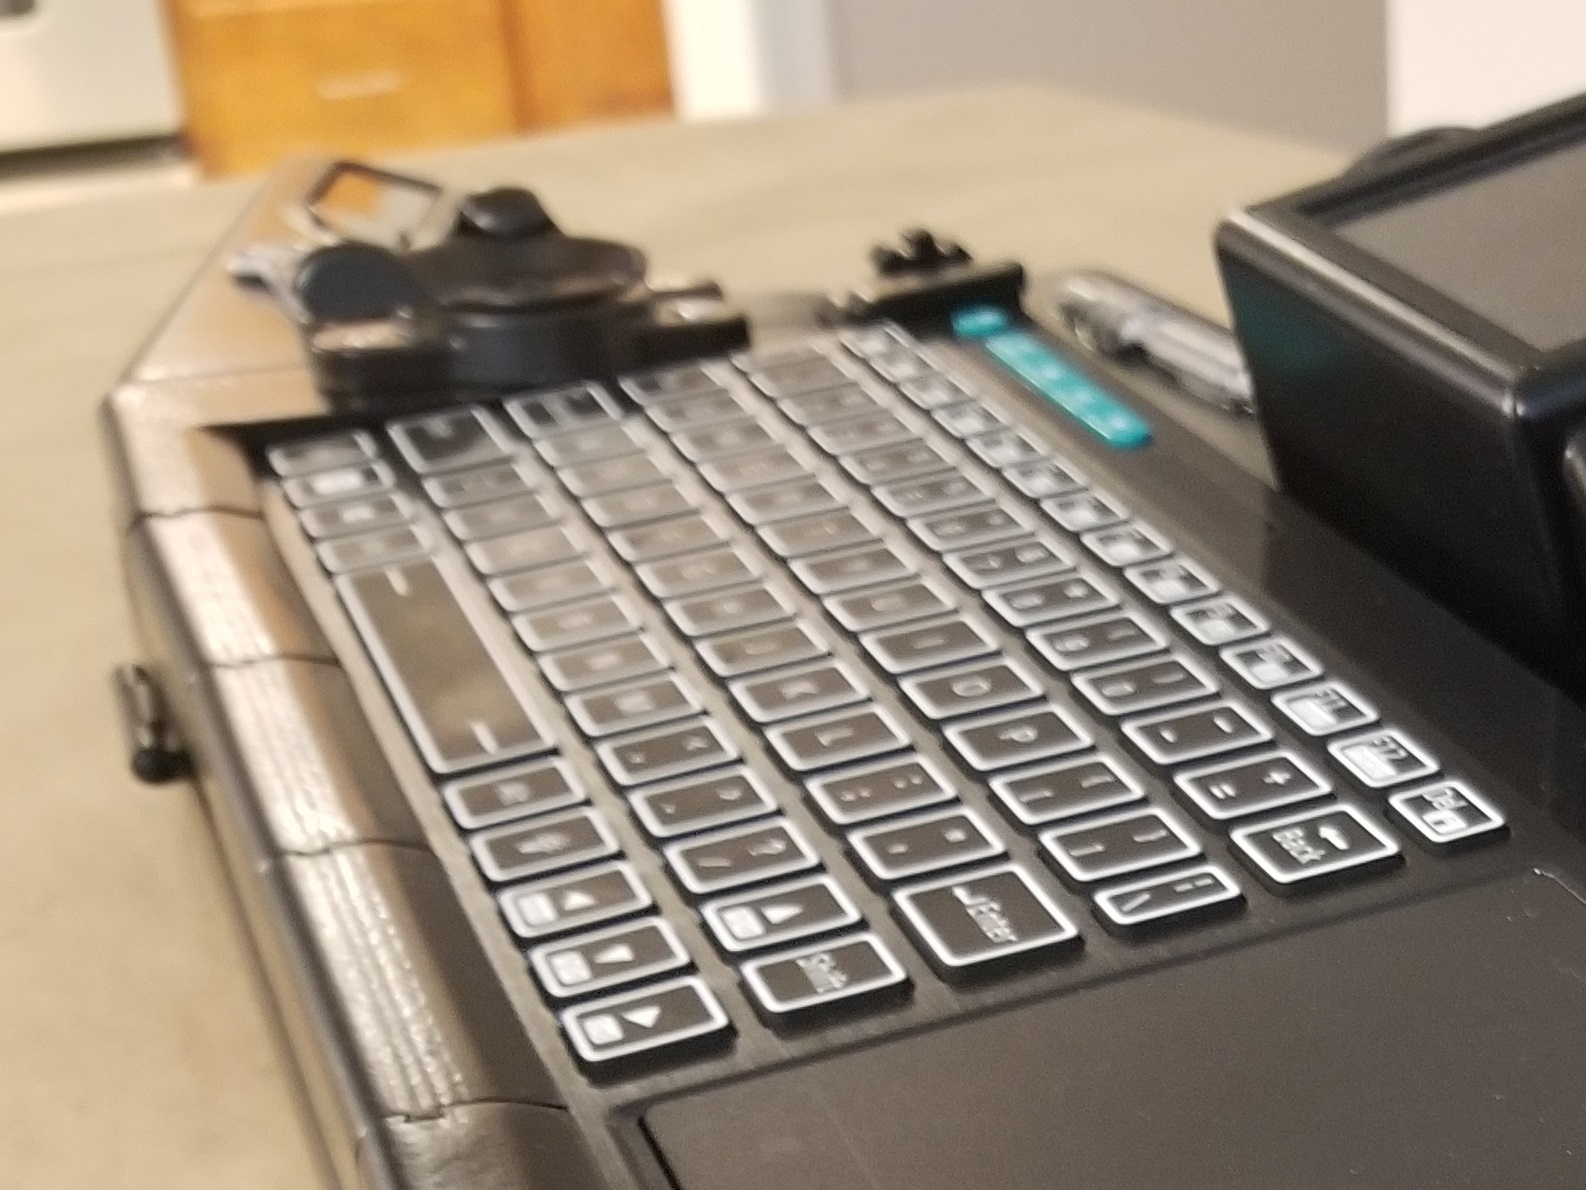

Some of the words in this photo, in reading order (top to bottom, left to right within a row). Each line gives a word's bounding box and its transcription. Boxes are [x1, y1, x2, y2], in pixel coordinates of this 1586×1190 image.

[951, 676, 992, 697] O
[814, 727, 855, 747] L
[999, 725, 1039, 743] P
[1367, 735, 1408, 762] F12
[1263, 769, 1291, 785] +
[1209, 783, 1236, 800] =
[1420, 786, 1468, 811] Del
[1272, 827, 1326, 865] Back
[966, 898, 1019, 943] Enter
[796, 952, 848, 993] Shift
